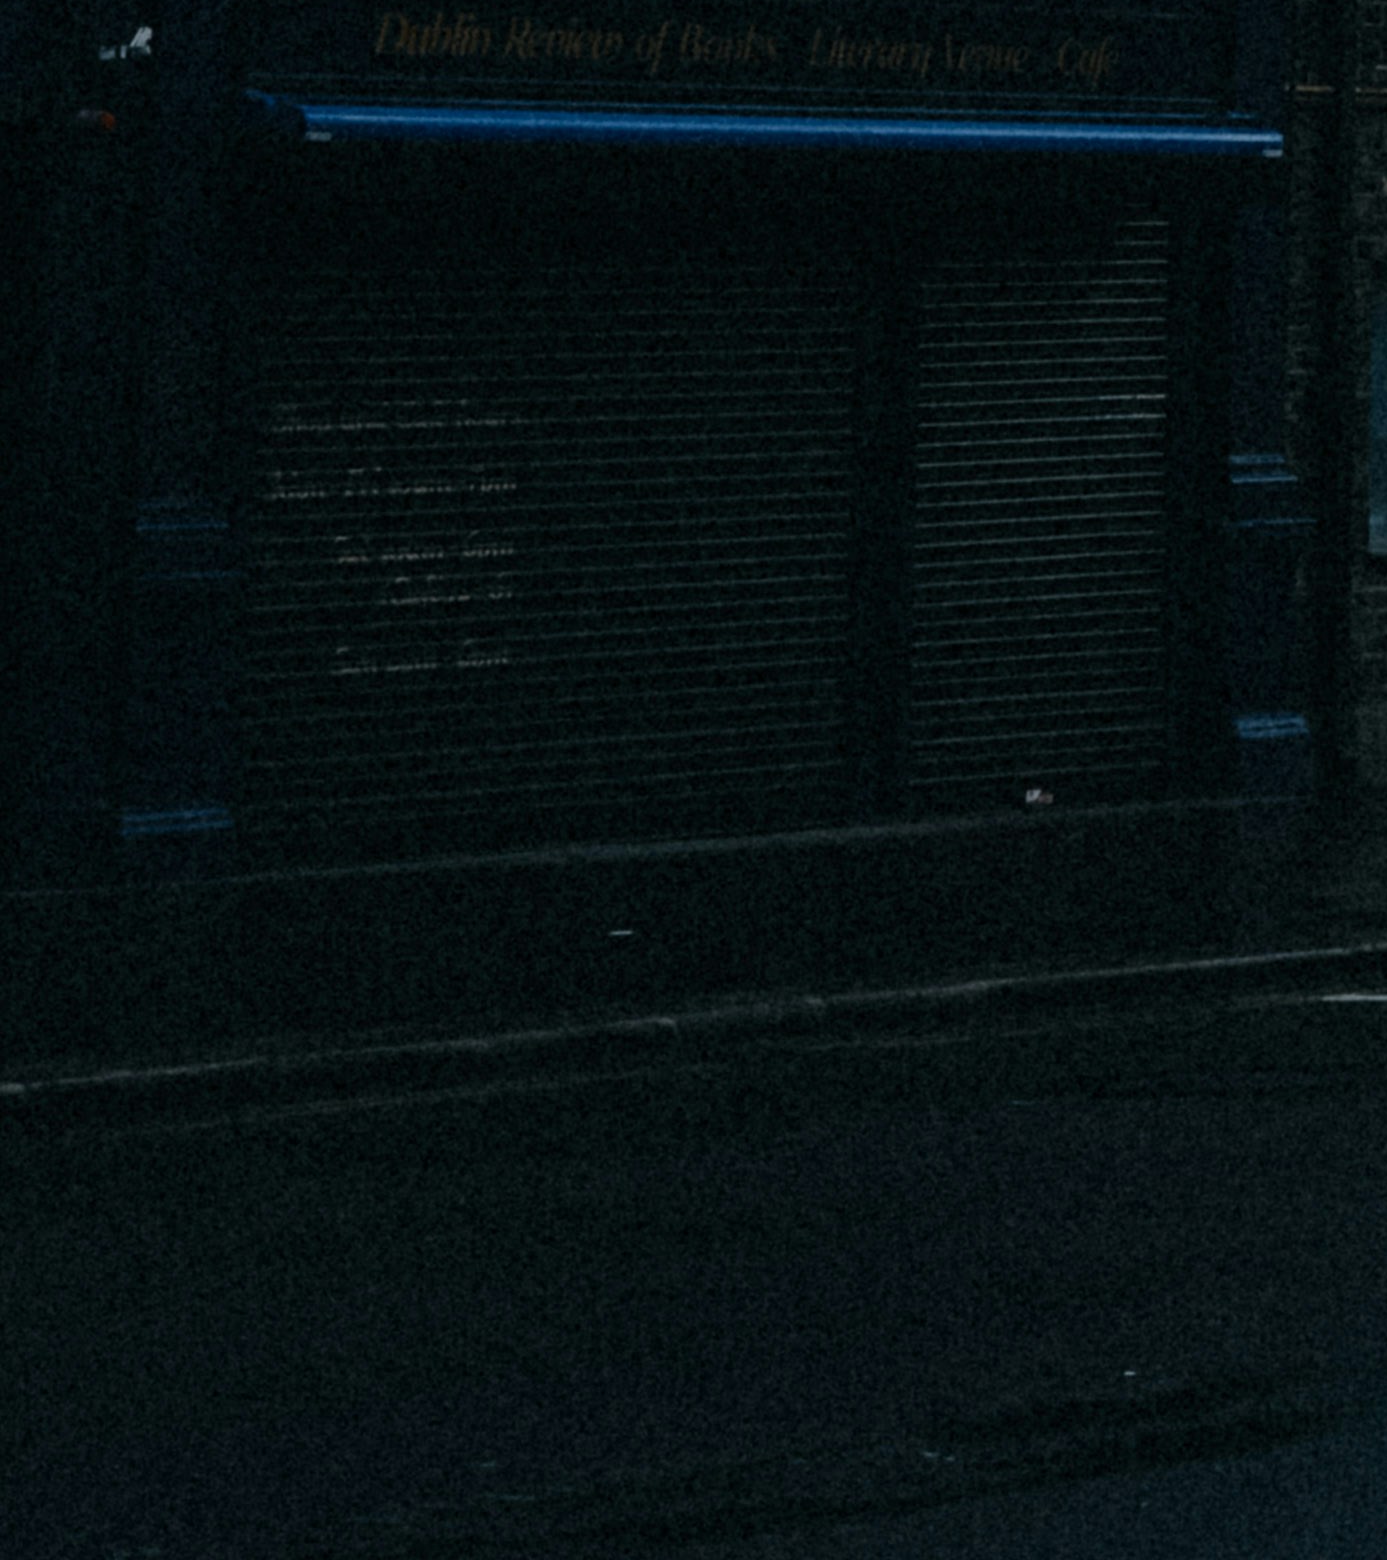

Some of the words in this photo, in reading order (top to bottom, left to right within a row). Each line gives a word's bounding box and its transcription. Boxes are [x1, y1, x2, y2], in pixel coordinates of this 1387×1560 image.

[375, 12, 492, 56] Dublin
[504, 17, 625, 60] Review
[635, 20, 672, 76] of
[680, 23, 779, 63] Books
[809, 25, 933, 79] Literary
